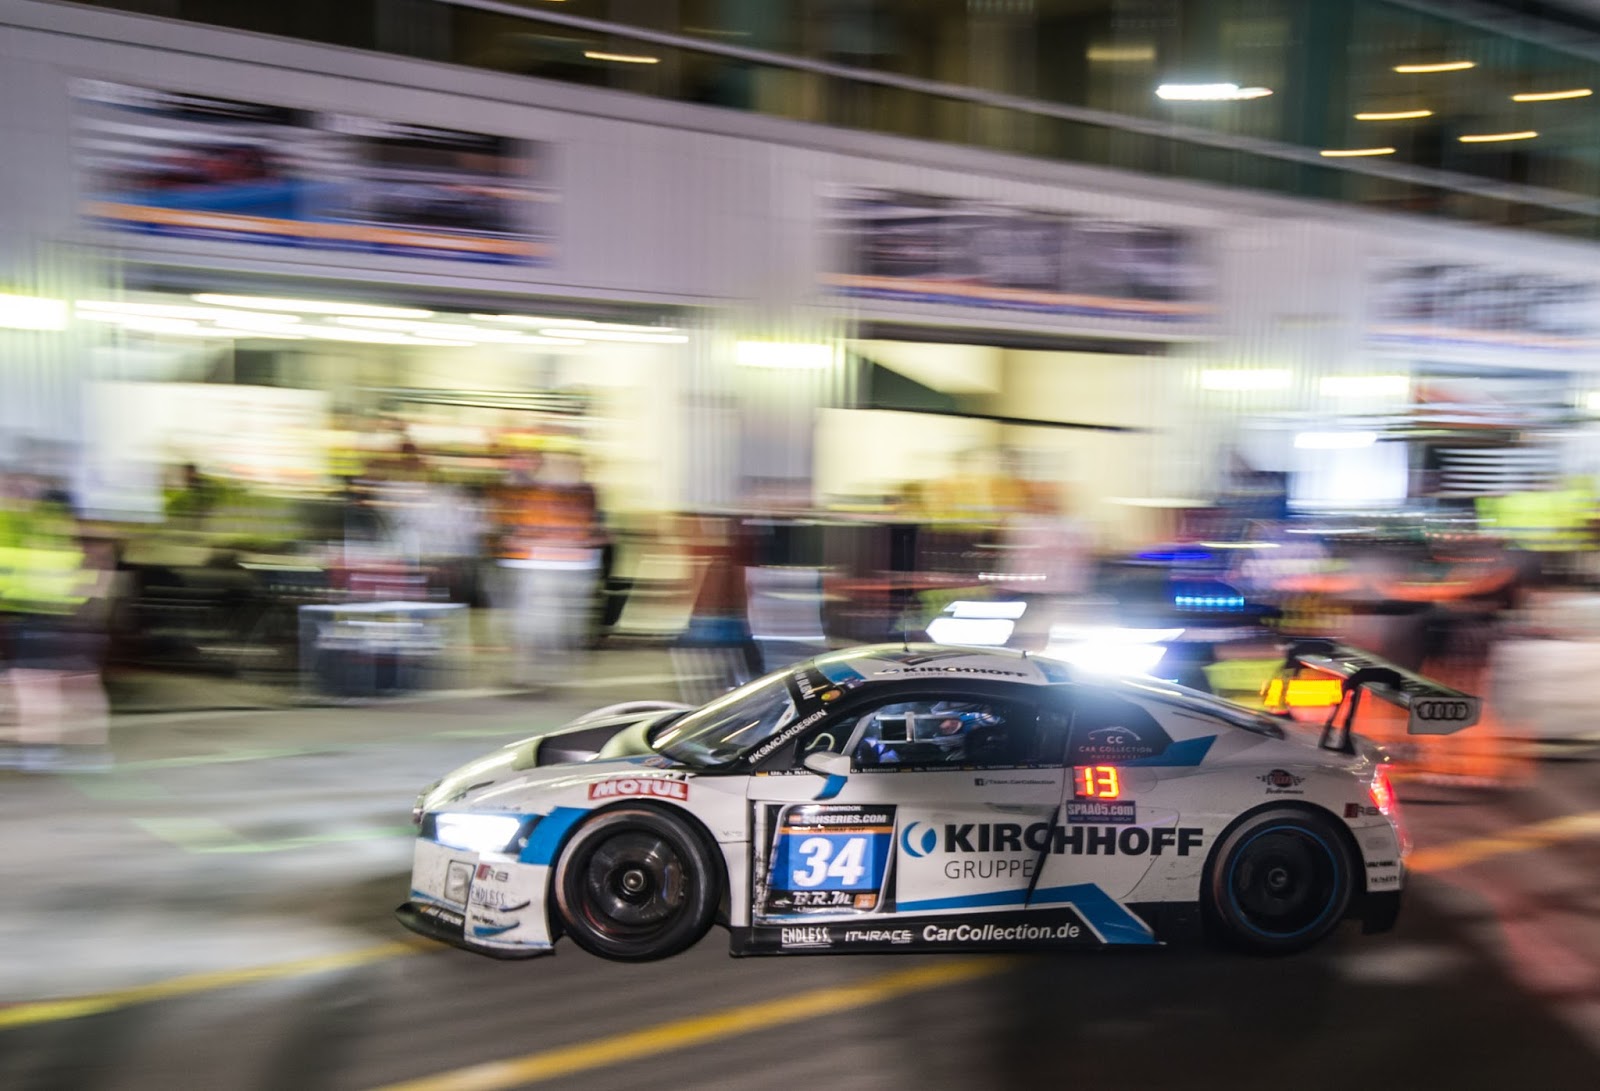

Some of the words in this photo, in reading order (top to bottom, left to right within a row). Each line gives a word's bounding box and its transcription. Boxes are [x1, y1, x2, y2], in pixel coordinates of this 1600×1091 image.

[903, 667, 1029, 677] KIRCHHOFF
[748, 709, 828, 764] #KSMCARDESIGN
[1106, 736, 1123, 744] CC
[592, 779, 685, 798] MOTUL
[1084, 766, 1119, 797] 13
[1067, 804, 1134, 816] SPAA05.com
[944, 822, 1203, 856] KIRCHHOFF
[792, 837, 868, 887] 34
[944, 859, 1034, 879] GRUPPE
[782, 927, 832, 944] ENDLESS
[923, 923, 1080, 942] CarCollection.de
